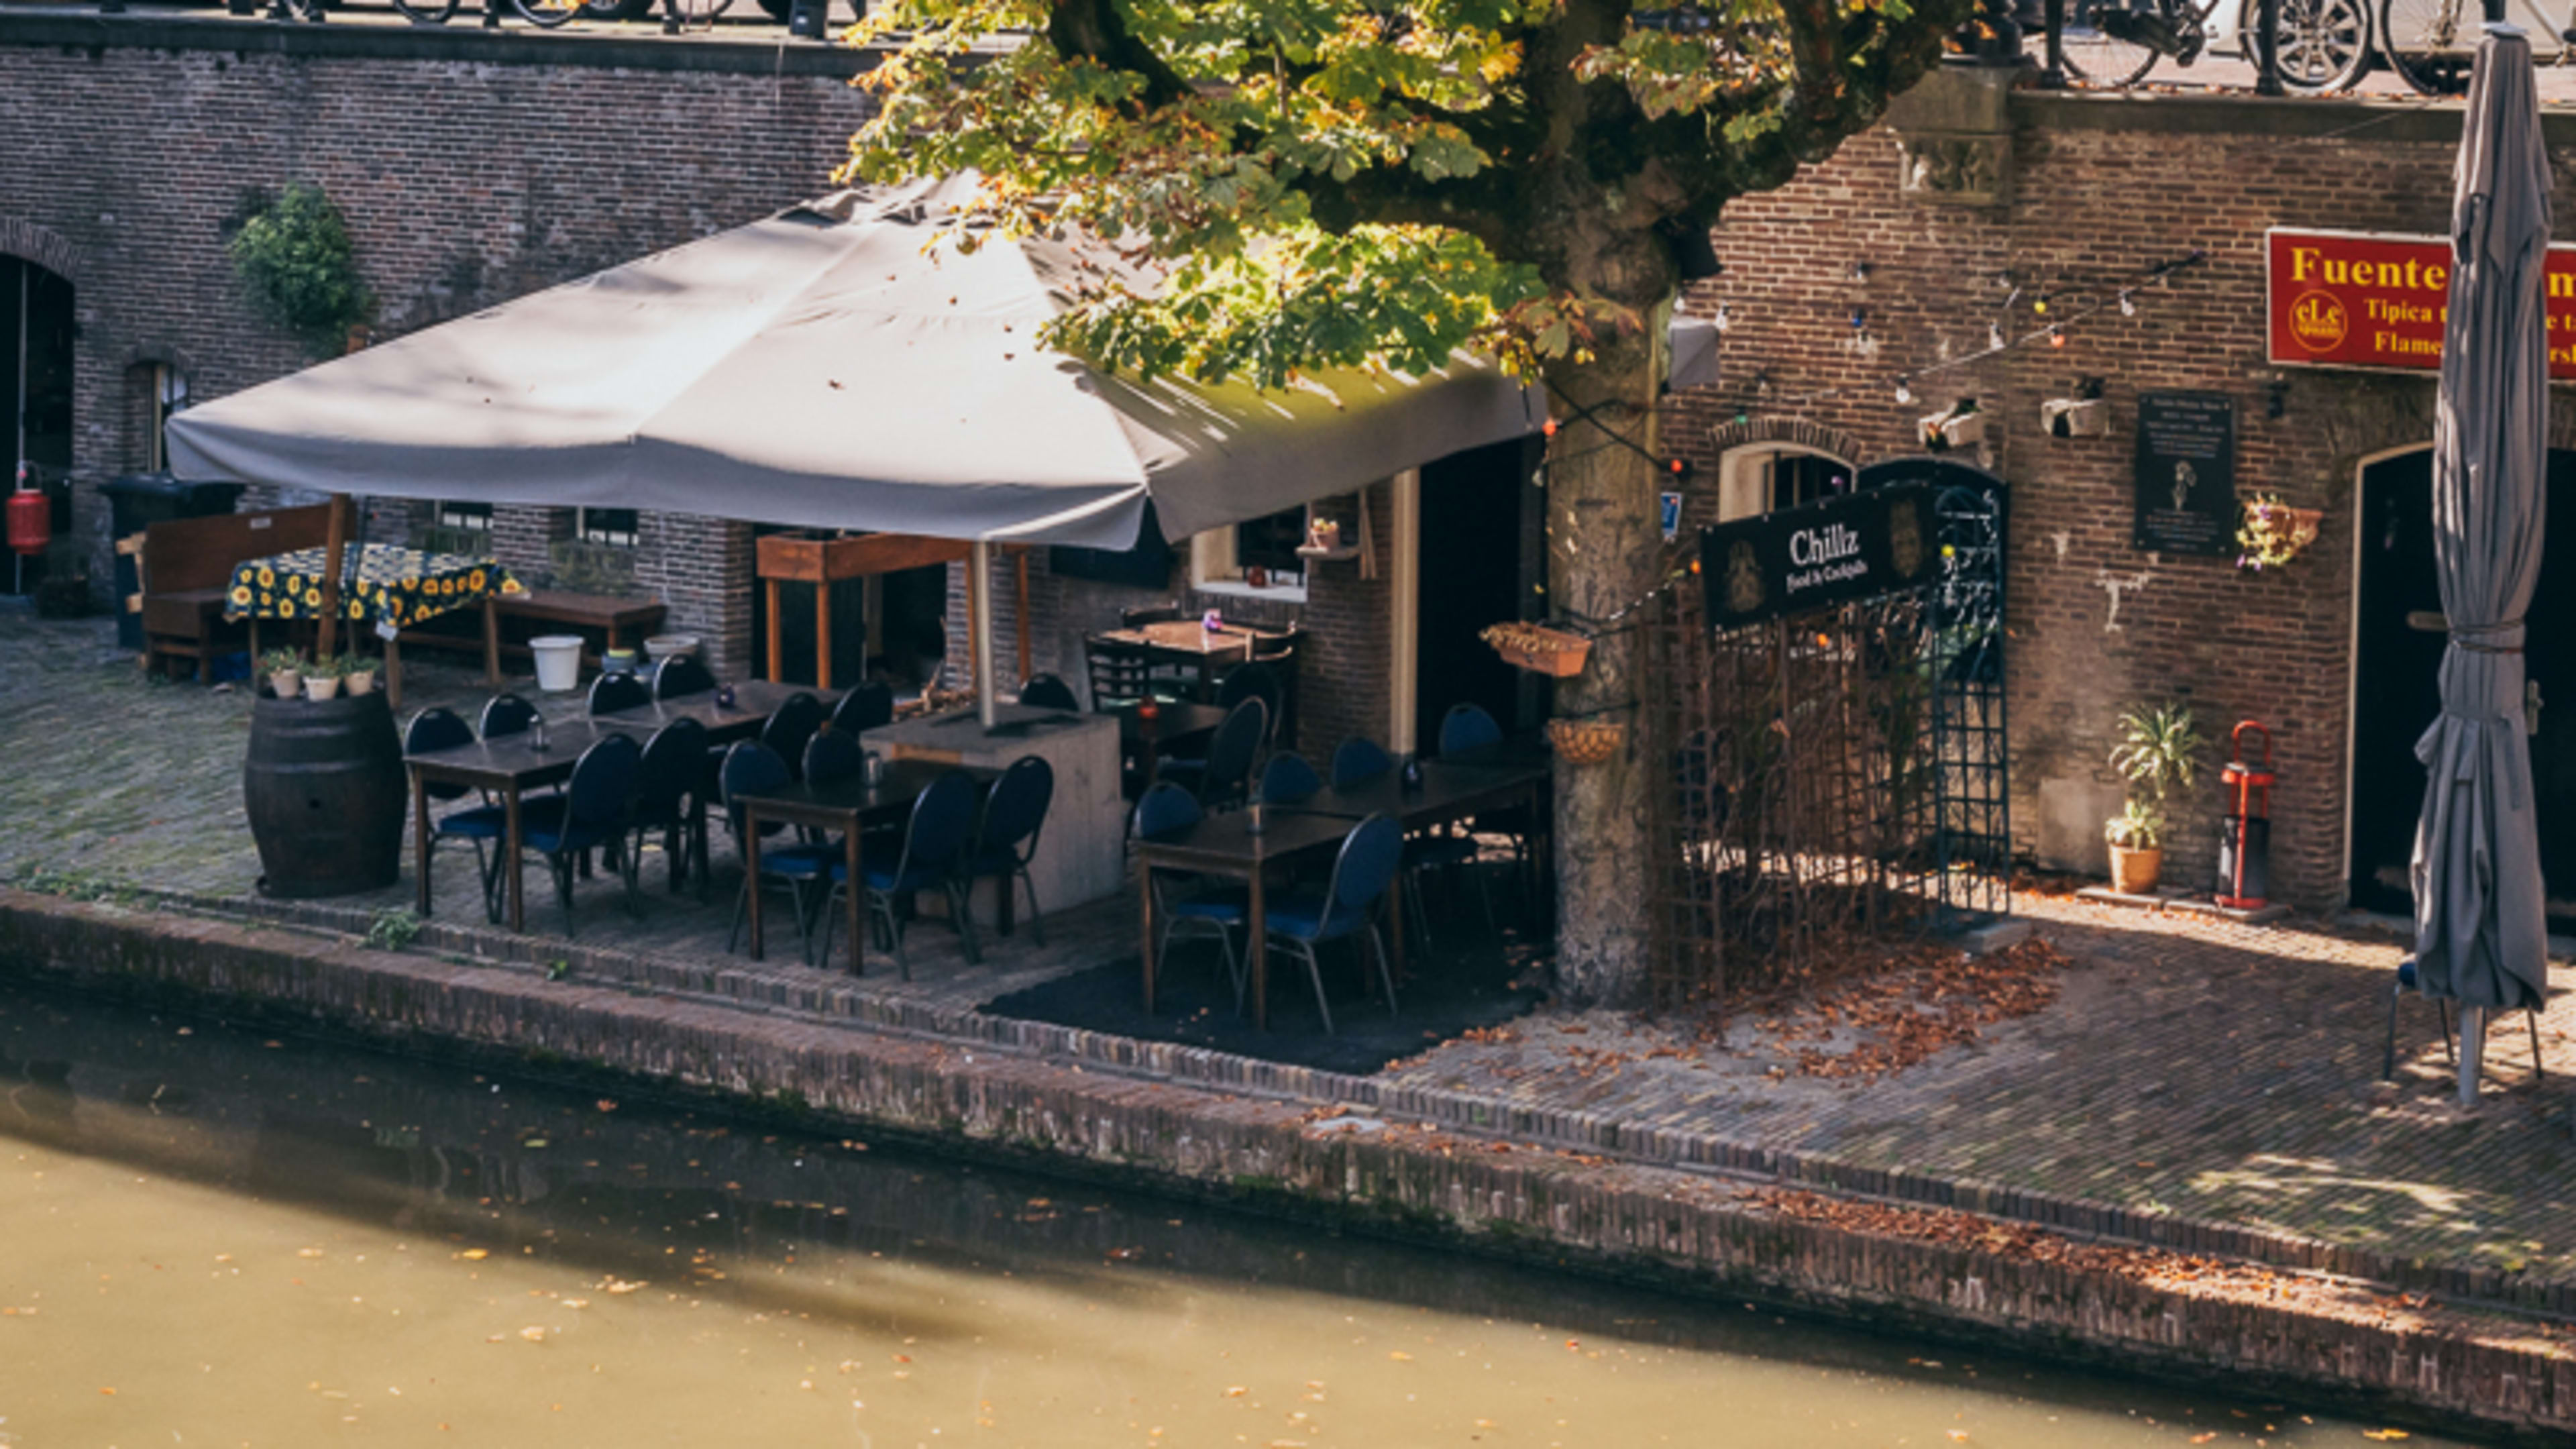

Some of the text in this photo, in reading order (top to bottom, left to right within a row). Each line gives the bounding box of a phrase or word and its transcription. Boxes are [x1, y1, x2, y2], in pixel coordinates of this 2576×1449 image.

[2290, 246, 2447, 290] Fuente
[2375, 331, 2443, 355] Flame
[1789, 523, 1860, 566] Chillz
